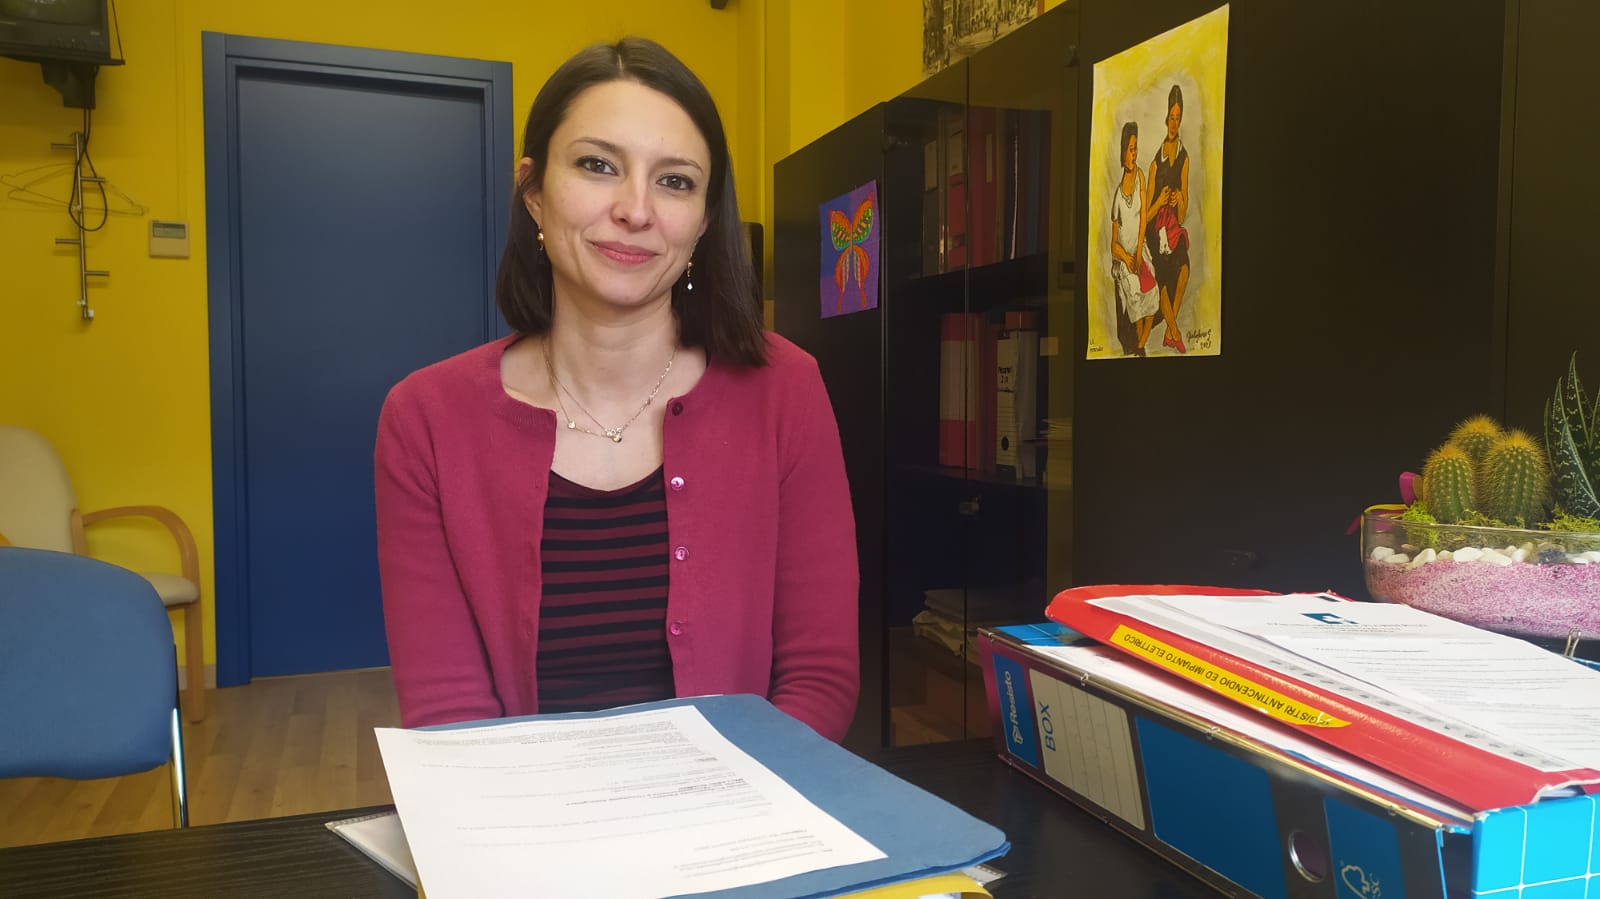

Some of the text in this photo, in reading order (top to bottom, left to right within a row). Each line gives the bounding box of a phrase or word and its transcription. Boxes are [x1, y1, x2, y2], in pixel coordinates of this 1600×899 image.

[1124, 634, 1166, 658] ELETTRICO
[1165, 653, 1206, 675] IMPIANTO
[1205, 670, 1219, 682] ED
[1004, 670, 1018, 726] Resisto
[1219, 677, 1285, 710] ANTINCENDIO
[1039, 700, 1056, 752] BOX
